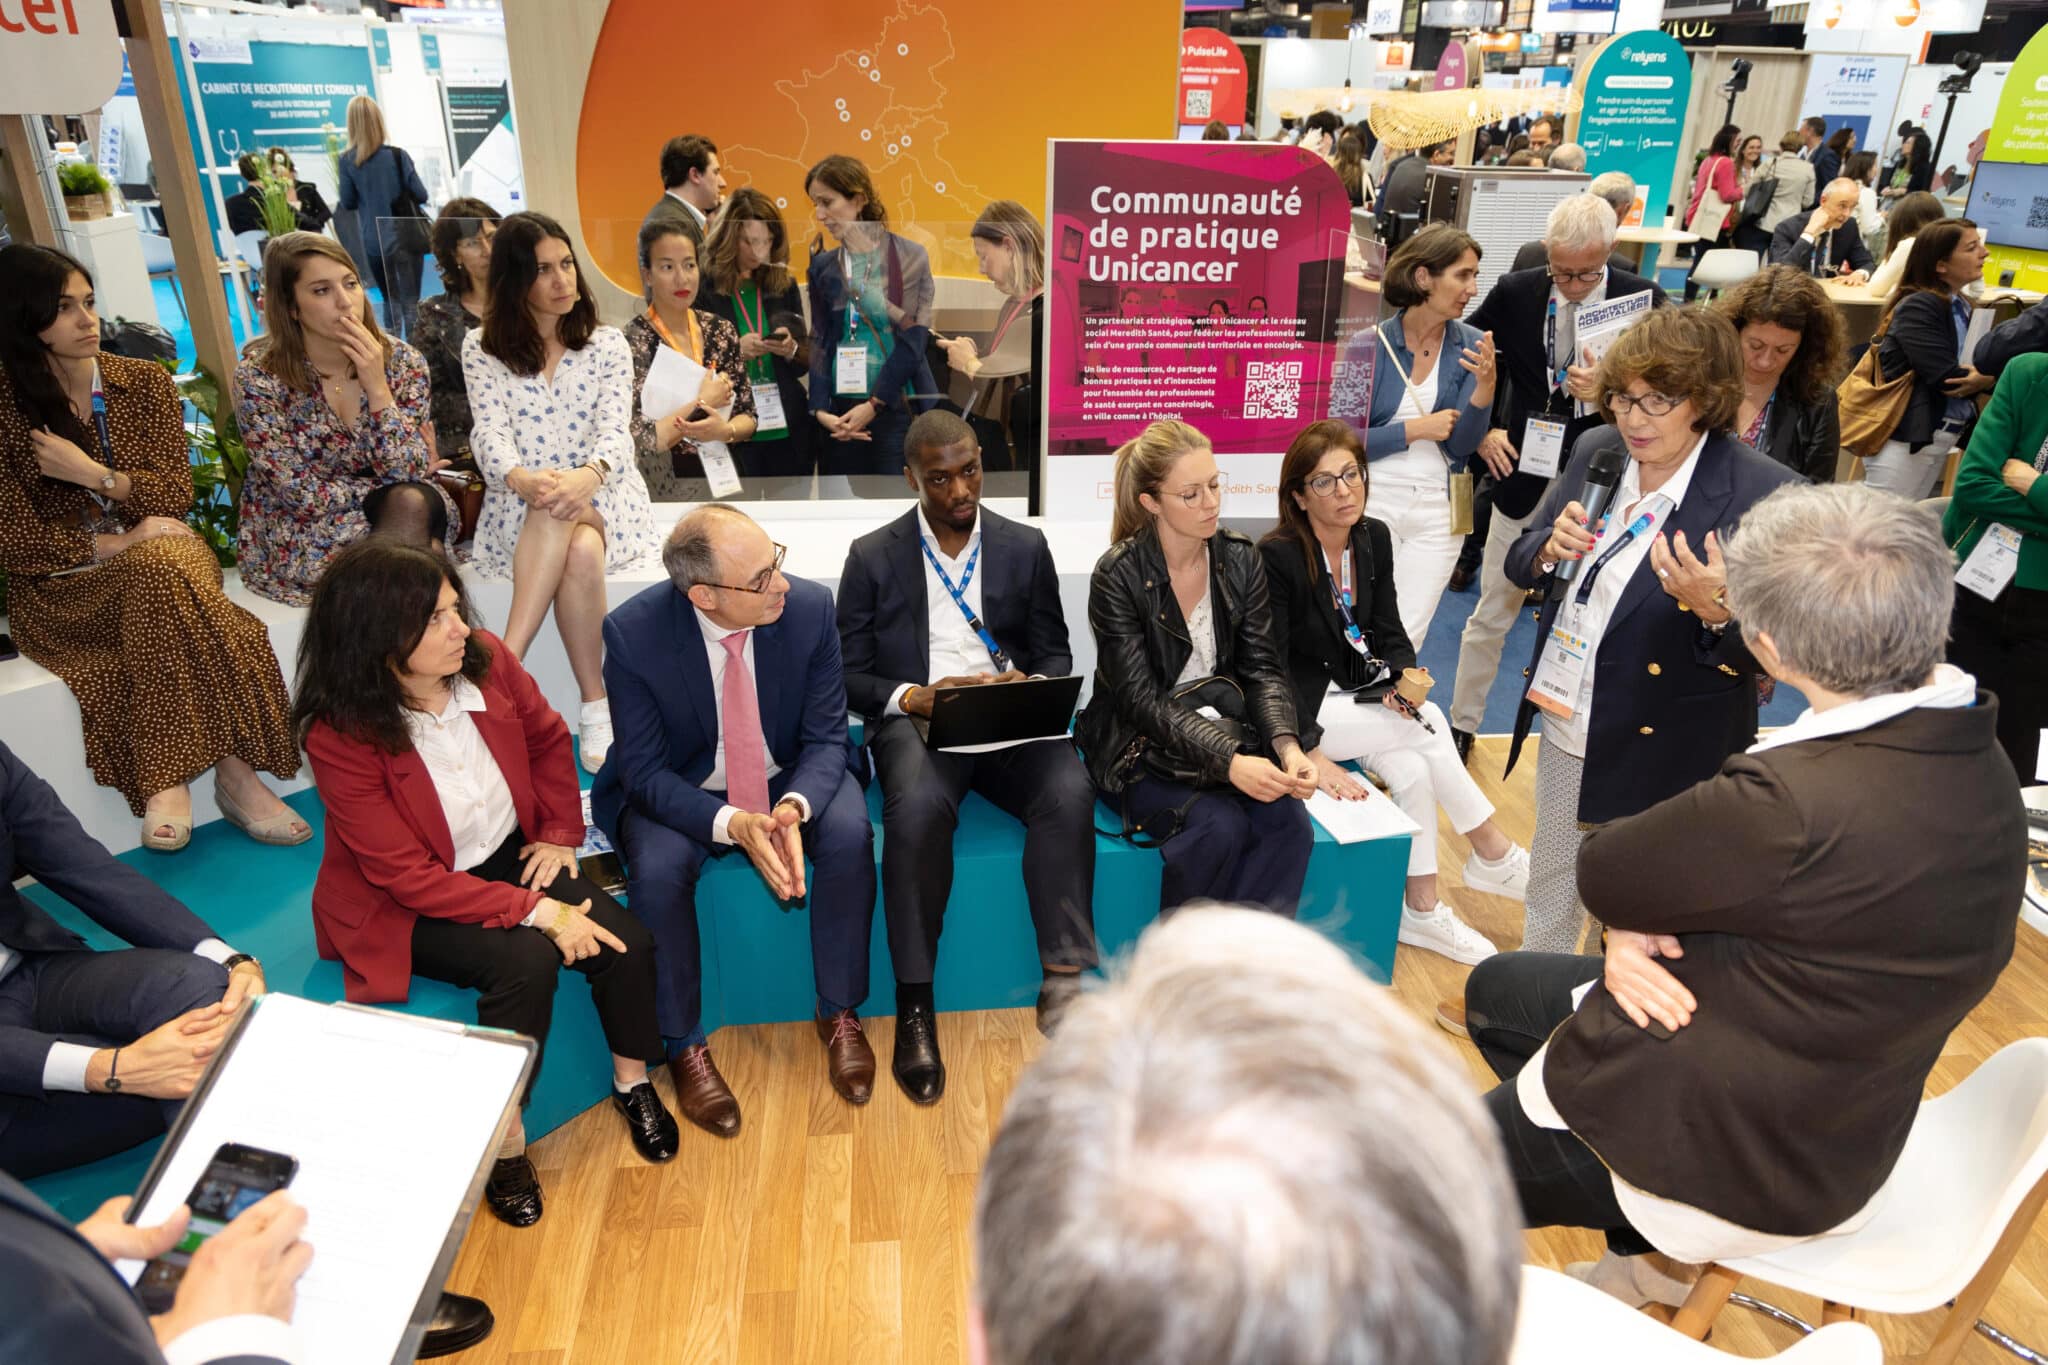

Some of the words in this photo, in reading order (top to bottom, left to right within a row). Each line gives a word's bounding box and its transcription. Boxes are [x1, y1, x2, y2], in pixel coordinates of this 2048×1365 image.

[1630, 50, 1667, 66] relyens
[1847, 67, 1877, 83] FHF
[202, 82, 239, 94] CABINET
[241, 83, 253, 94] DE
[254, 83, 313, 95] RECRUTEMENT
[314, 84, 324, 95] ET
[325, 84, 356, 95] CONSEIL
[1091, 186, 1302, 215] Communauté
[1089, 218, 1129, 248] de
[1140, 219, 1279, 255] pratique
[1089, 253, 1239, 282] Unicancer
[1578, 295, 1650, 321] ARCHITECTURE
[1086, 317, 1097, 325] Un
[1098, 317, 1145, 326] partenariat
[1146, 317, 1195, 326] stratégique,
[1196, 317, 1219, 325] entre
[1220, 317, 1259, 325] Unicancer
[1260, 317, 1269, 325] et
[1270, 317, 1279, 325] le
[1280, 317, 1307, 325] réseau
[1085, 329, 1109, 337] social
[1110, 329, 1147, 337] Meredith
[1147, 329, 1173, 338] Santé,
[1193, 329, 1224, 337] fédérer
[1224, 329, 1236, 337] les
[1237, 329, 1295, 338] professionnels
[1085, 341, 1102, 349] sein
[1103, 341, 1125, 349] d'une
[1126, 341, 1154, 351] grande
[1155, 341, 1206, 349] communauté
[1207, 341, 1252, 349] territoriale
[1264, 341, 1304, 351] oncologie.
[1096, 365, 1111, 373] lieu
[1122, 366, 1165, 374] ressources,
[1177, 366, 1207, 374] partage
[1083, 377, 1113, 385] bonnes
[1113, 377, 1152, 386] pratiques
[1153, 377, 1162, 385] et
[1163, 376, 1216, 385] d'interactions
[1083, 390, 1102, 398] pour
[1103, 389, 1144, 397] l'ensemble
[1144, 389, 1159, 397] des
[1159, 389, 1215, 398] professionnels
[1082, 401, 1093, 409] de
[1094, 401, 1117, 409] santé
[1117, 402, 1151, 410] exerçant
[1164, 400, 1215, 410] cancérologie,
[1094, 412, 1112, 420] ville
[1142, 412, 1148, 420] à
[1148, 412, 1183, 422] l'hôpital.
[1256, 483, 1279, 495] San
